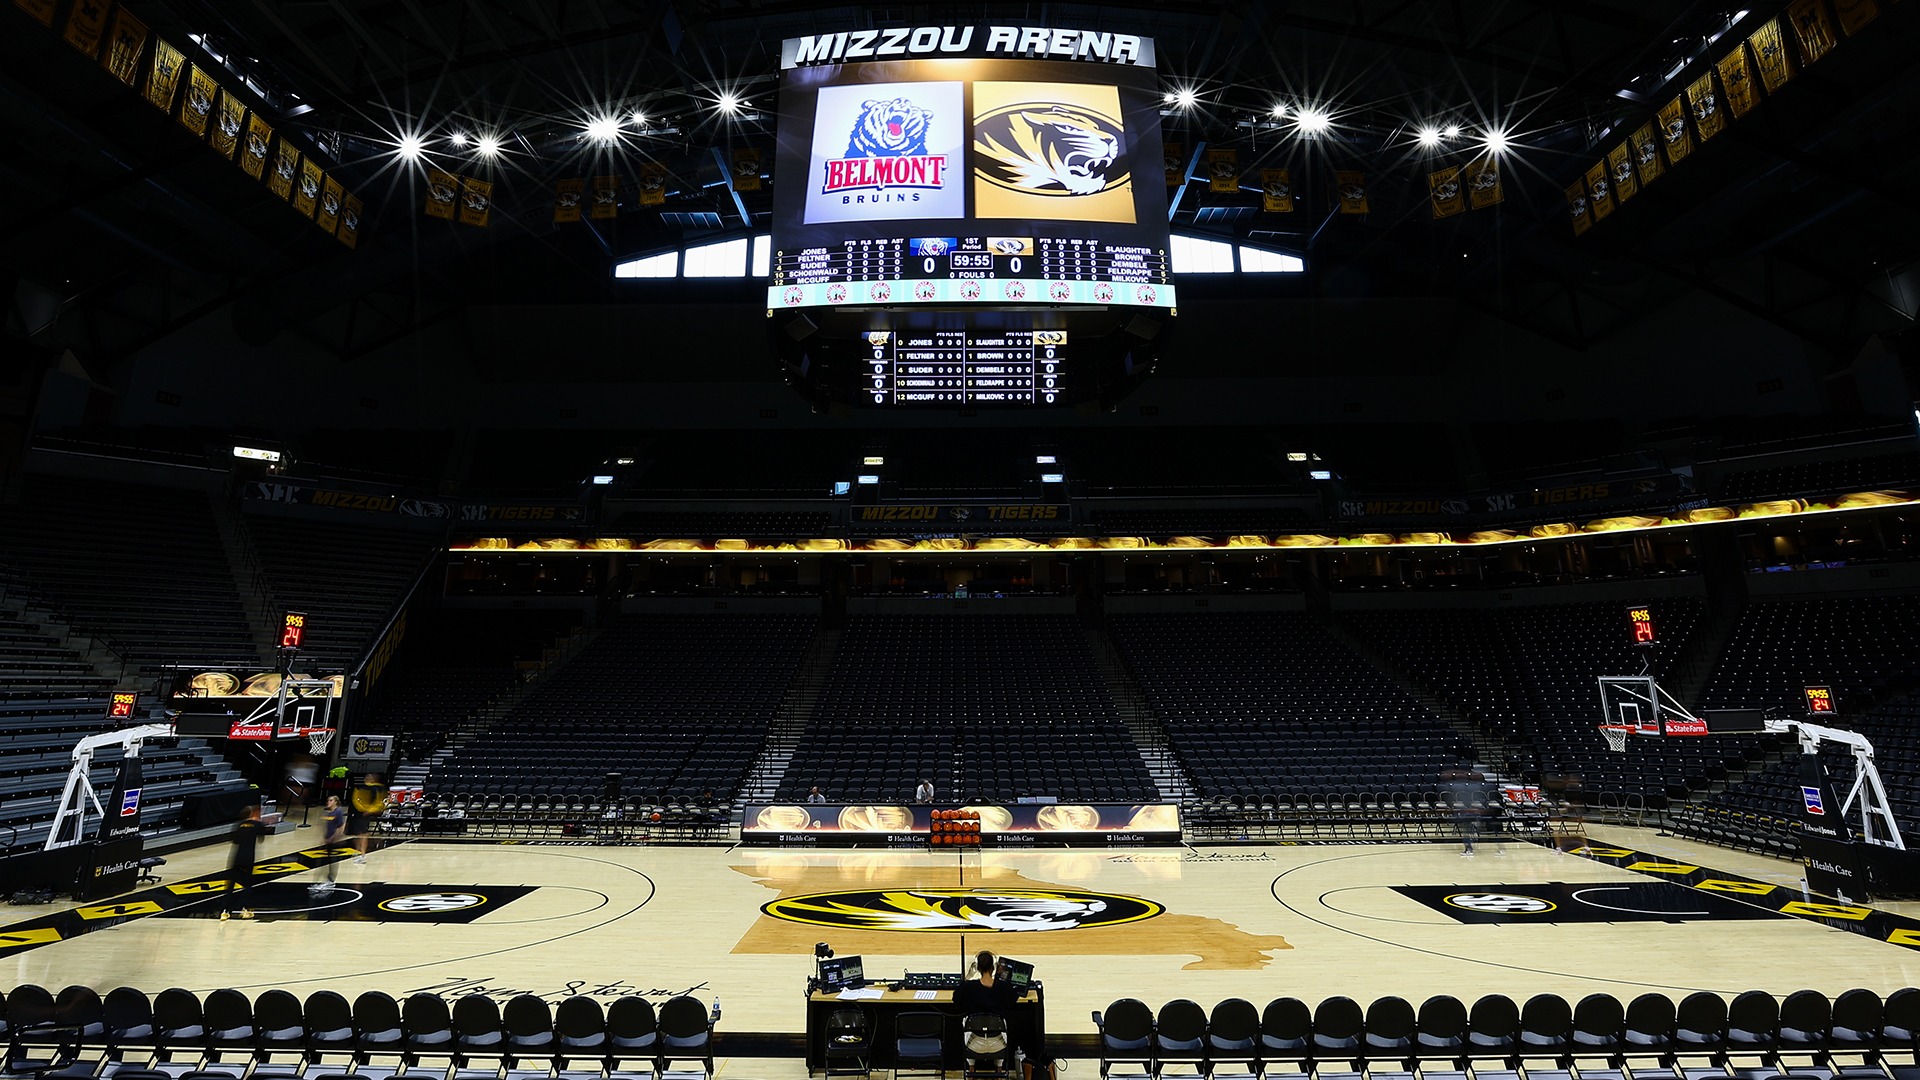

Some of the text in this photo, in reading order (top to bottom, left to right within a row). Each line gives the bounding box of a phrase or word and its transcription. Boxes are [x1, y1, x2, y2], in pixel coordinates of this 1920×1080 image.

[796, 26, 1140, 62] MIZZOU ARENA
[827, 155, 946, 189] BELMONT
[842, 192, 921, 204] BRUINS
[1106, 246, 1151, 255] SLAUGHTER
[924, 258, 935, 273] 0
[954, 256, 990, 266] 59:55
[1011, 258, 1021, 272] 0
[789, 268, 838, 278] SCHOENWALD
[875, 350, 882, 359] 0
[1046, 350, 1054, 358] 0
[875, 365, 882, 374] 0
[1046, 364, 1054, 373] 0
[875, 379, 882, 388] 0
[1046, 379, 1054, 388] 0
[875, 394, 882, 403] 0
[1046, 394, 1054, 403] 0
[1531, 482, 1610, 506] TIGERS
[311, 489, 399, 513] MIZZOU
[488, 505, 556, 520] TIGERS
[862, 506, 1058, 520] MIZZOU TIGERS
[1366, 502, 1440, 515] MIZZOU
[286, 614, 303, 627] 59:55
[1631, 610, 1650, 622] 59:55
[283, 627, 300, 646] 24
[1635, 622, 1653, 641] 24
[113, 693, 134, 704] 59:55
[1807, 689, 1829, 699] 59:55
[113, 704, 129, 715] 24
[1814, 699, 1829, 711] 24
[356, 739, 369, 753] SEC
[103, 860, 139, 876] Health Care
[1812, 859, 1853, 877] Health Care
